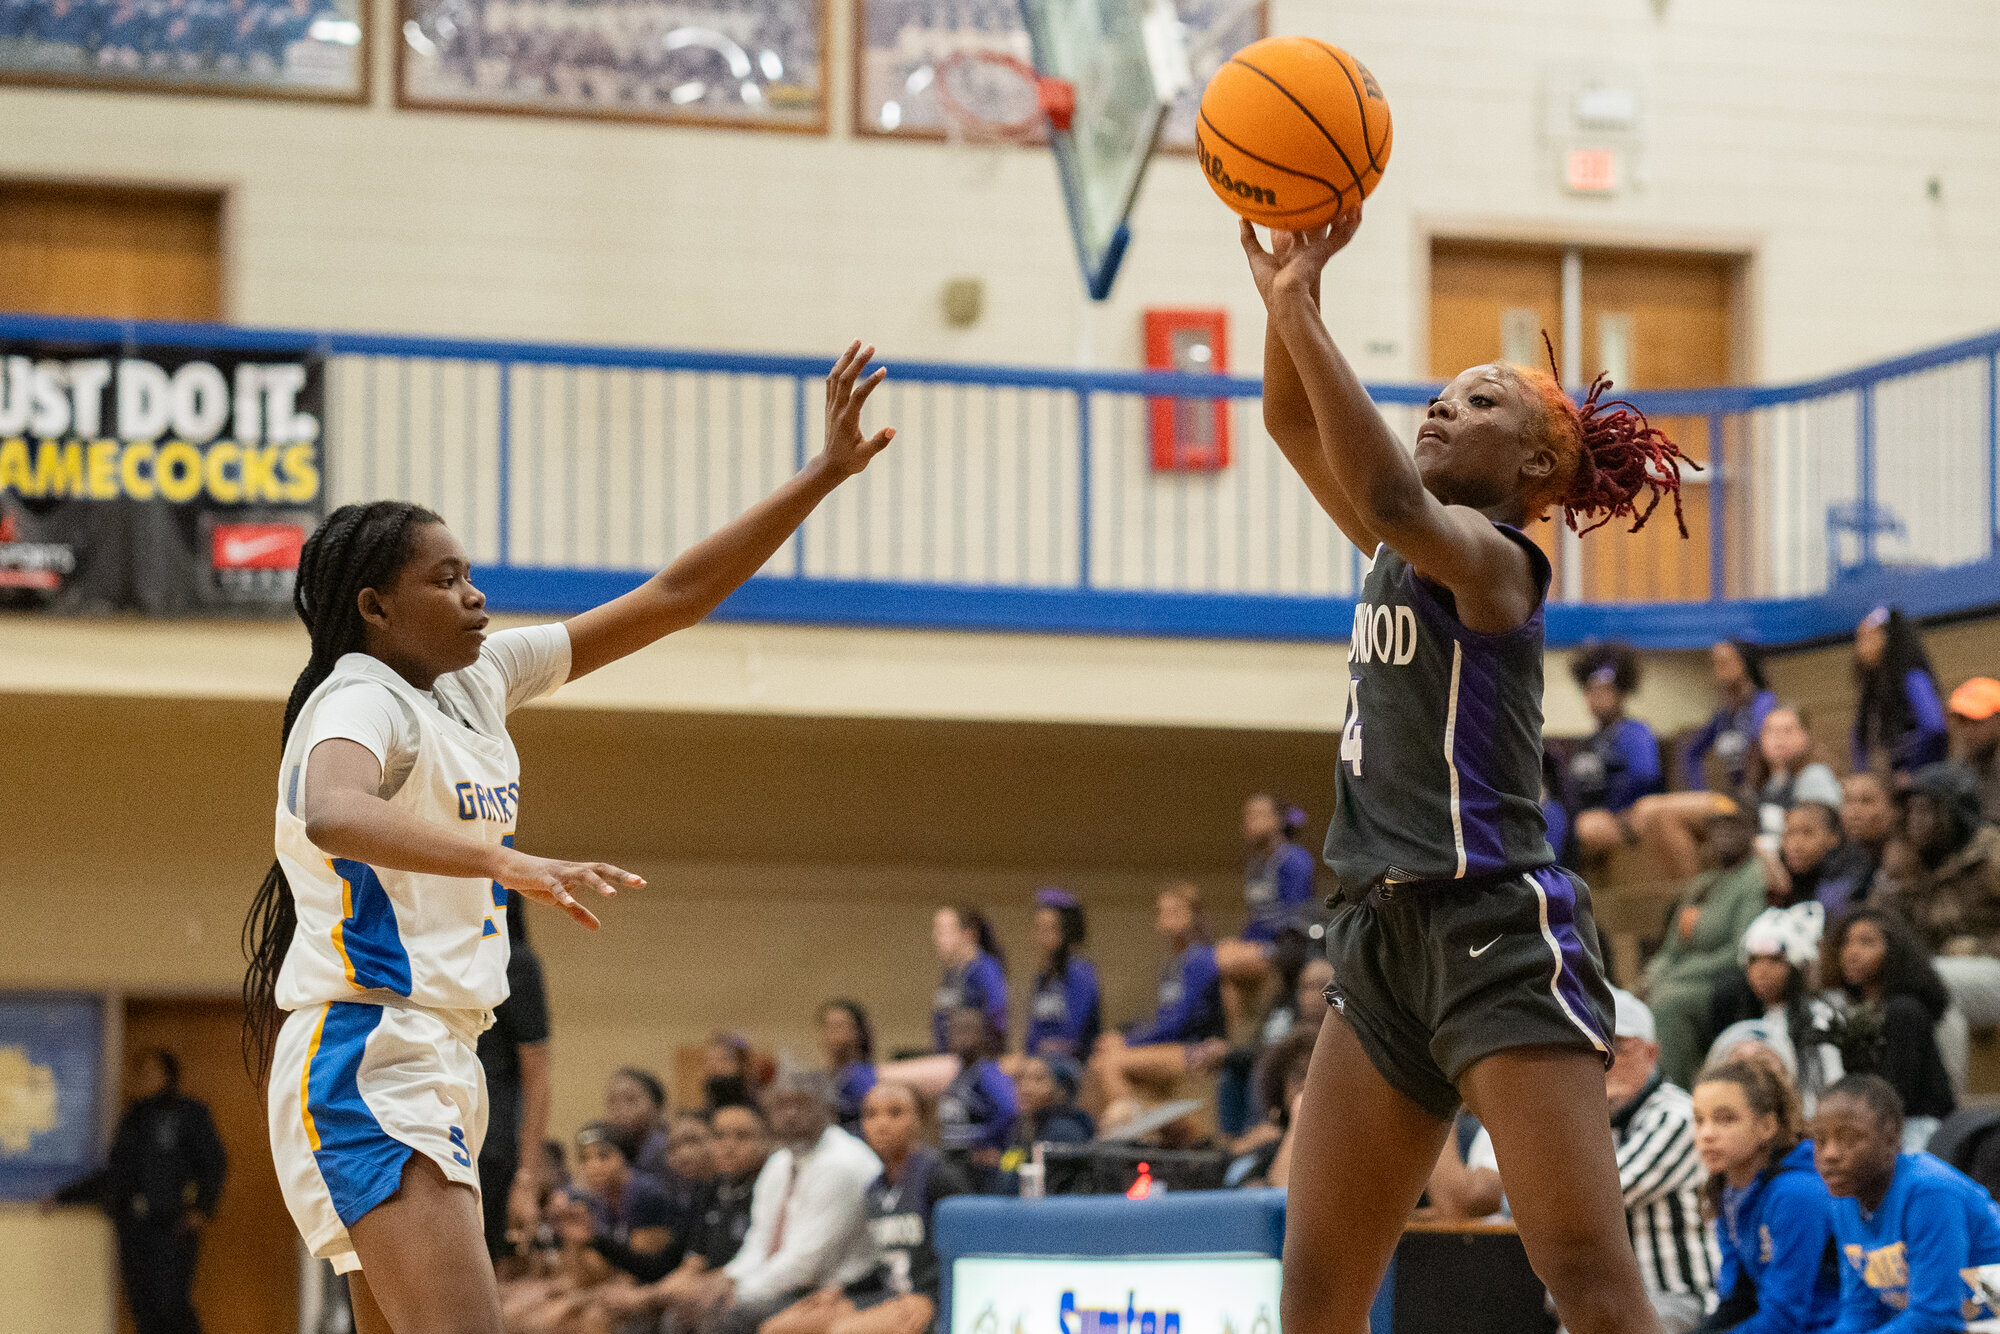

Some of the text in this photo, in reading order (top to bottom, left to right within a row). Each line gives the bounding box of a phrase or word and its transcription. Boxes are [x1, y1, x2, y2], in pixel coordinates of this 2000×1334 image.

[117, 358, 229, 443] DO
[233, 362, 320, 444] IT.
[0, 438, 319, 502] AMECOCKS
